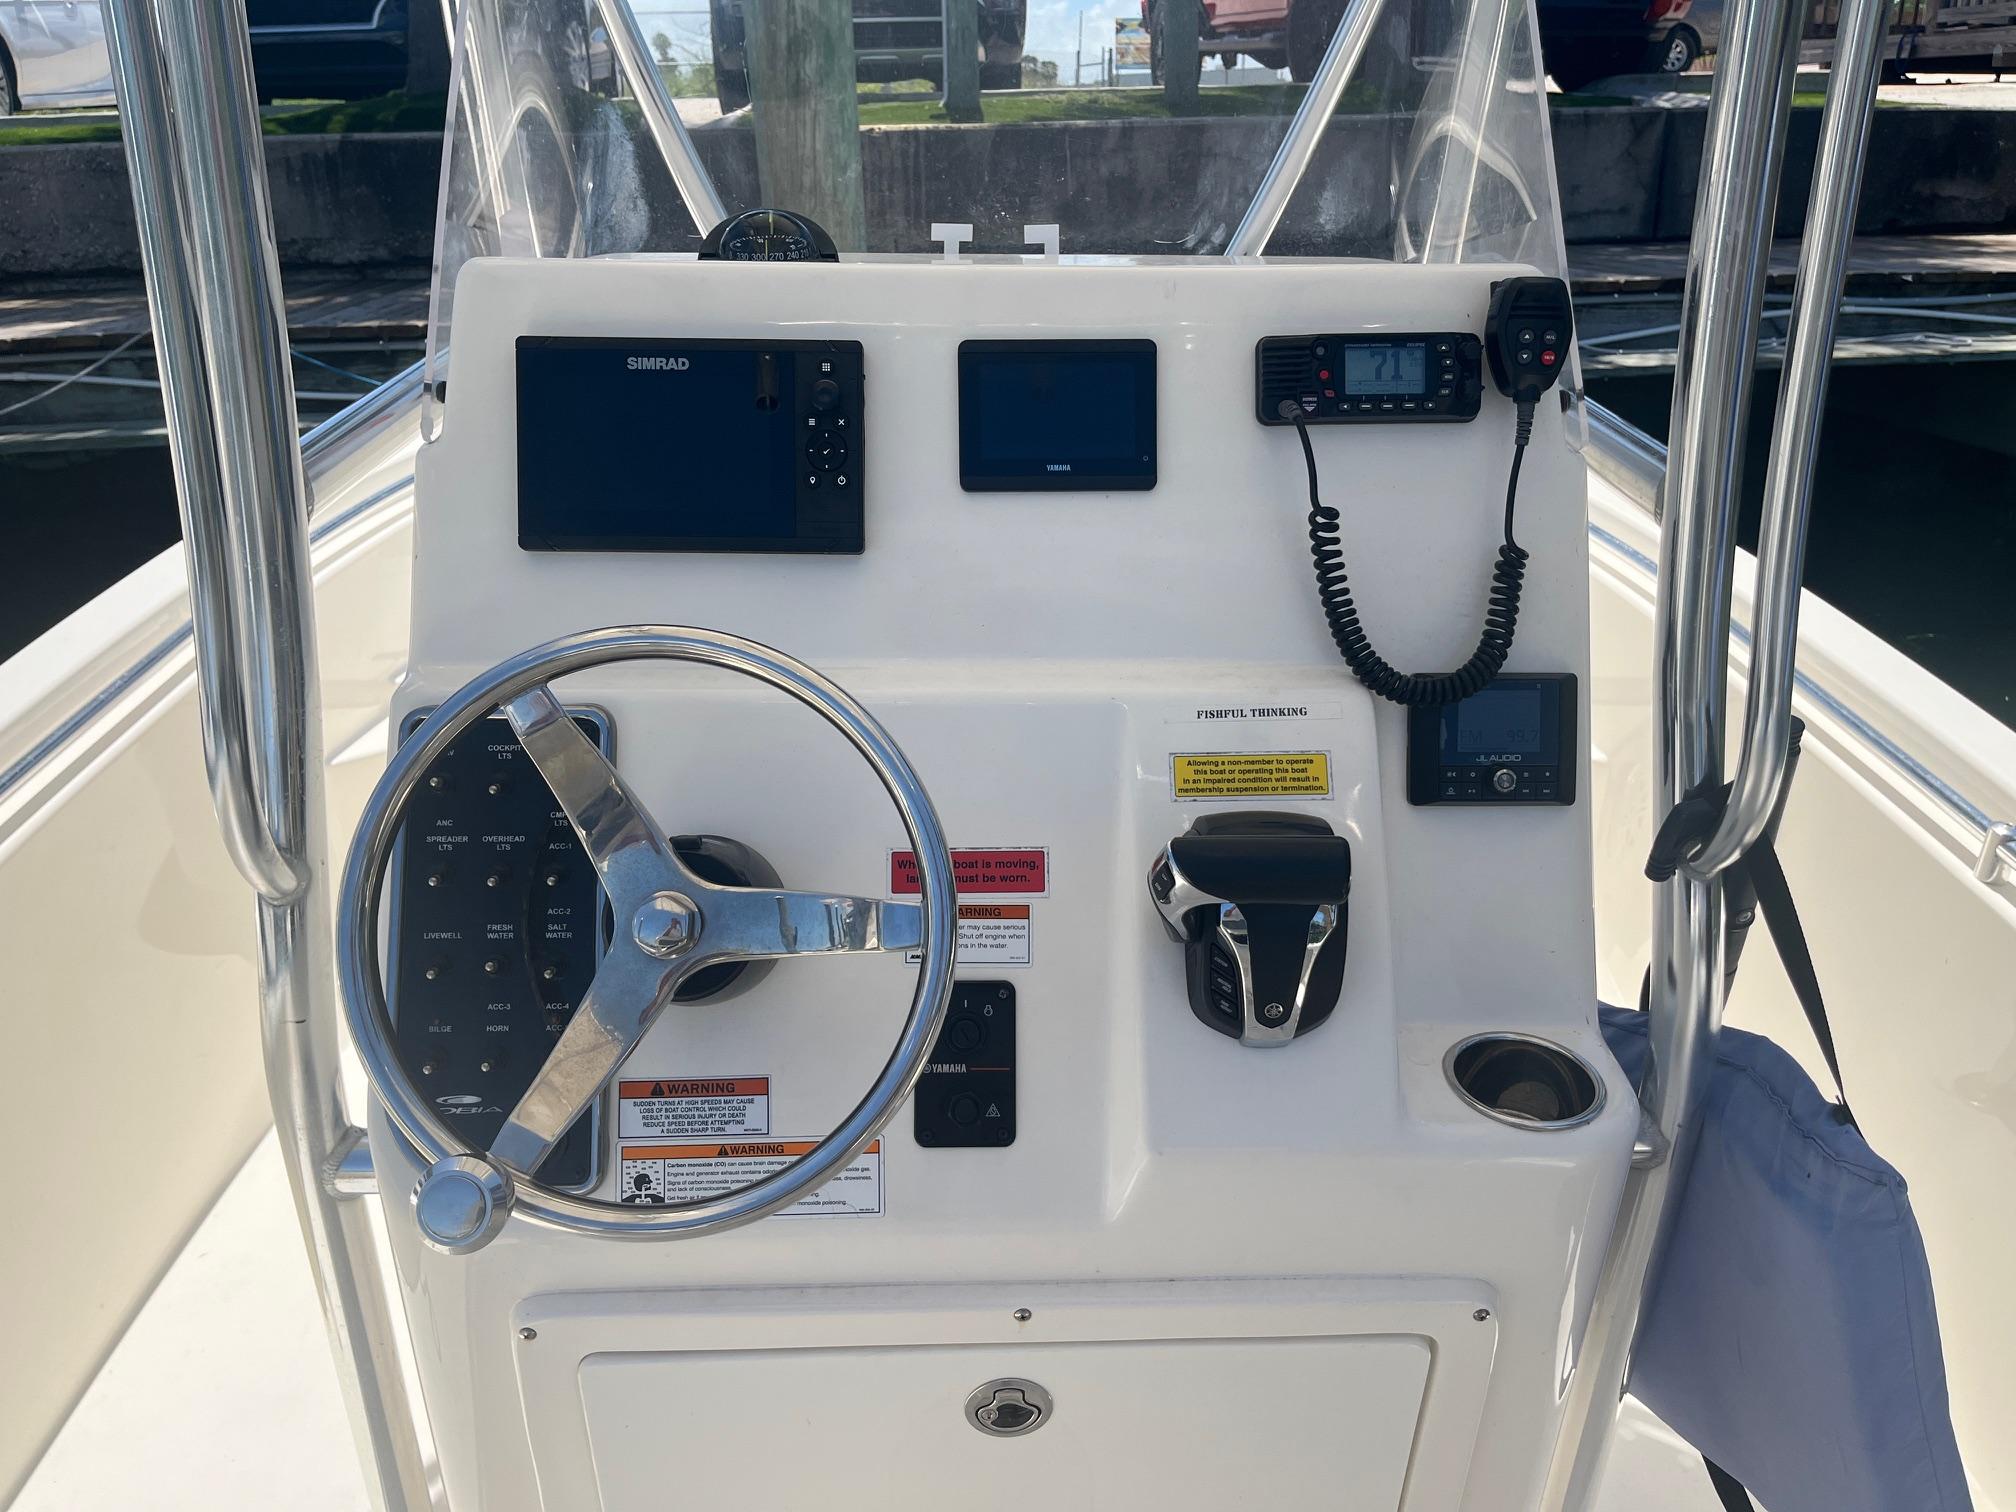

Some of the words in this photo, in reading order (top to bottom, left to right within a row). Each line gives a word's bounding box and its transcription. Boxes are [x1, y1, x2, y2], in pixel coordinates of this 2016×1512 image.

[787, 252, 799, 260] 240
[627, 357, 689, 370] SIMRAD
[1197, 709, 1247, 719] FISHFUL
[1250, 707, 1307, 718] THINKING
[1238, 768, 1273, 776] operating
[1203, 777, 1235, 785] impaired
[954, 860, 978, 869] boat
[982, 860, 991, 869] is
[995, 859, 1039, 870] moving,
[982, 874, 996, 883] be
[958, 908, 1001, 917] ARNING
[932, 1064, 967, 1073] YAMAHA
[668, 1083, 735, 1094] WARNING
[730, 1145, 784, 1155] WARNING
